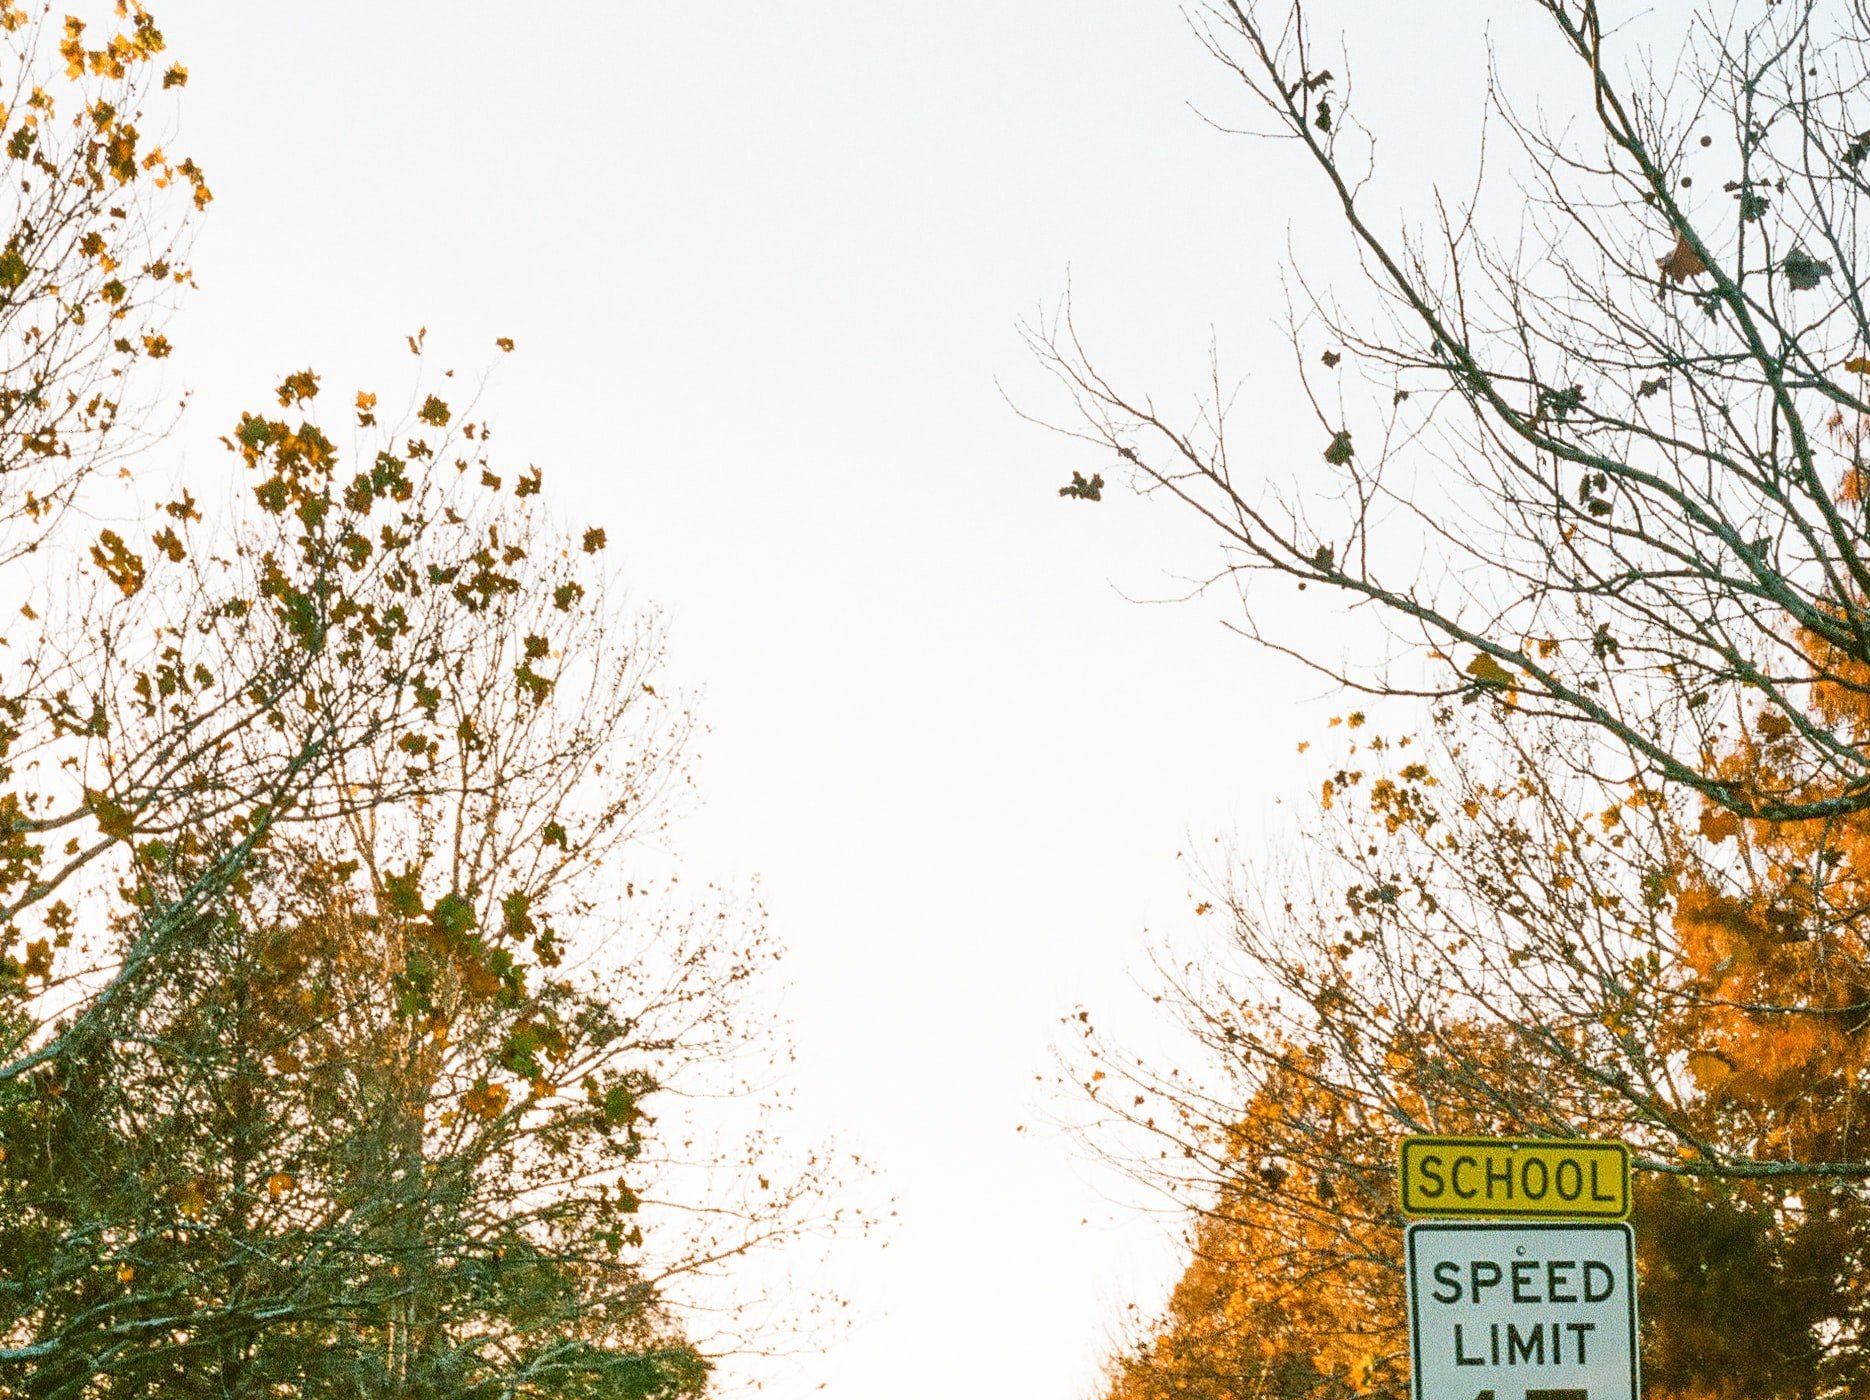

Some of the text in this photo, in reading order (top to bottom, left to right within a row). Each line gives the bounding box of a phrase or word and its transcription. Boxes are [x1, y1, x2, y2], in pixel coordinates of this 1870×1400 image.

[1418, 1154, 1616, 1202] SCHOOL
[1431, 1260, 1616, 1304] SPEED
[1454, 1322, 1596, 1367] LIMIT
